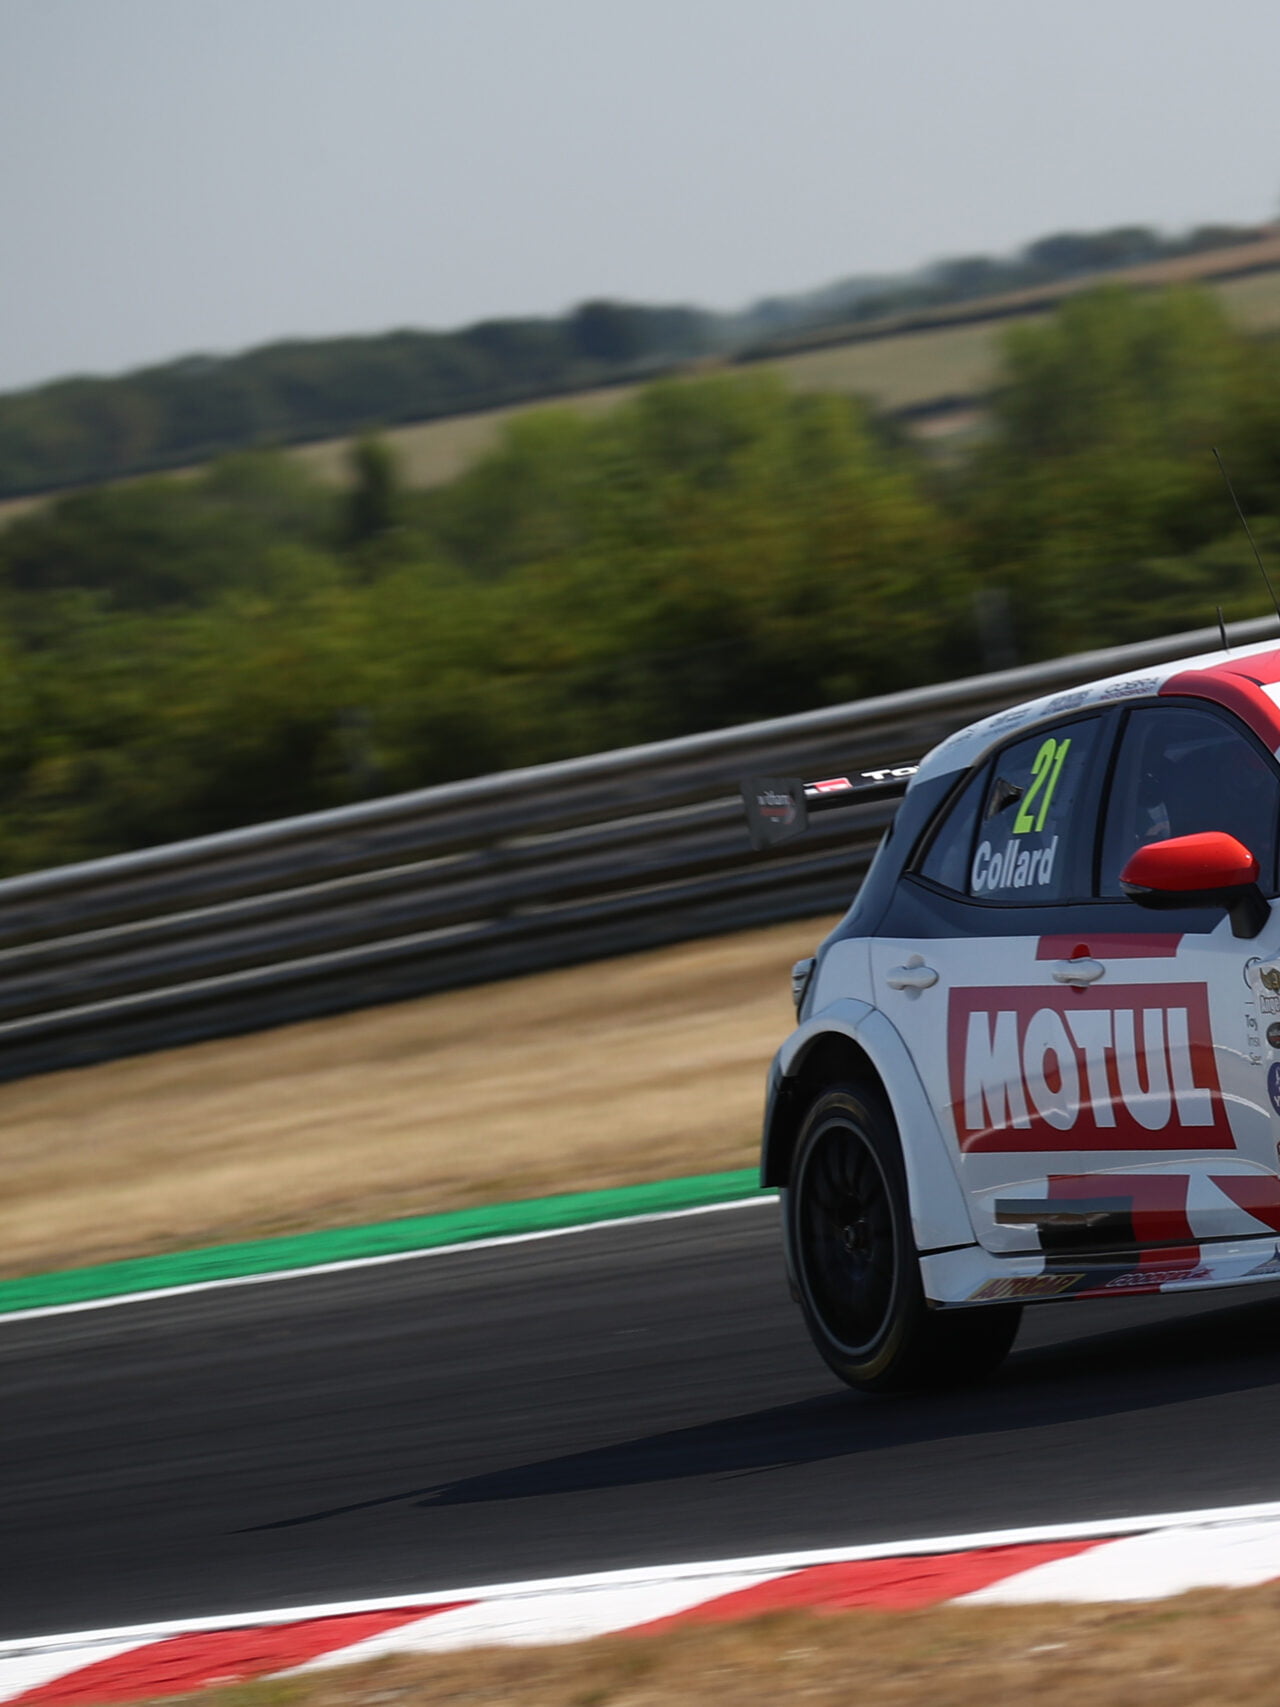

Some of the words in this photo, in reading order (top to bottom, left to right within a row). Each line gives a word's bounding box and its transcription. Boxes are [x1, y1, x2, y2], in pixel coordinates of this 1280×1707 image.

[861, 765, 920, 780] TO
[1012, 738, 1072, 834] 21
[971, 836, 1059, 892] Collard
[964, 1007, 1215, 1131] MOTUL
